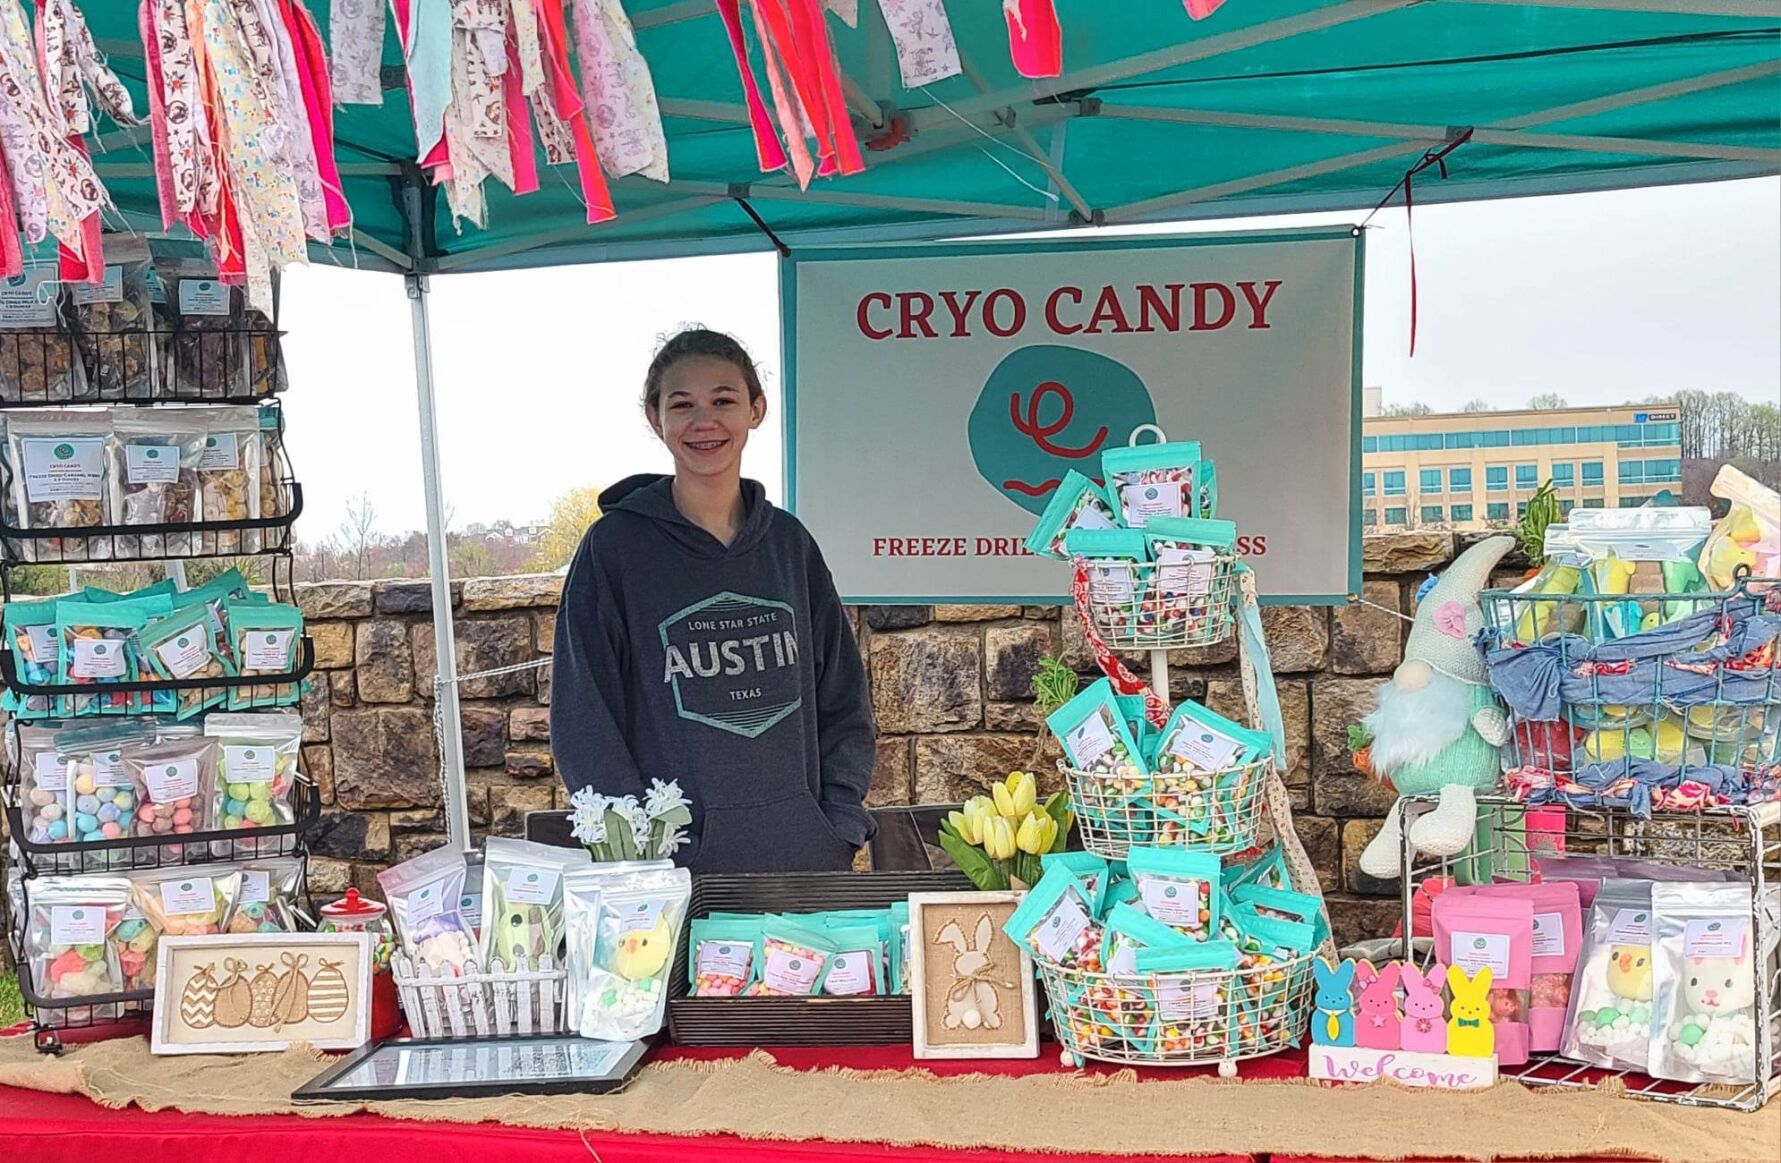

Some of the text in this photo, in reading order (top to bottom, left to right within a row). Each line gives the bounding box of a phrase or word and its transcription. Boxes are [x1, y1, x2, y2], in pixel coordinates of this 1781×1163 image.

[857, 280, 1283, 340] CRYO CANDY
[872, 537, 967, 556] FREEZE
[975, 537, 1036, 556] DRI
[688, 612, 777, 631] LONE STAR STATE
[663, 630, 799, 684] AUSTIN
[729, 687, 762, 701] TEXAS
[1323, 1054, 1478, 1087] Welcome
